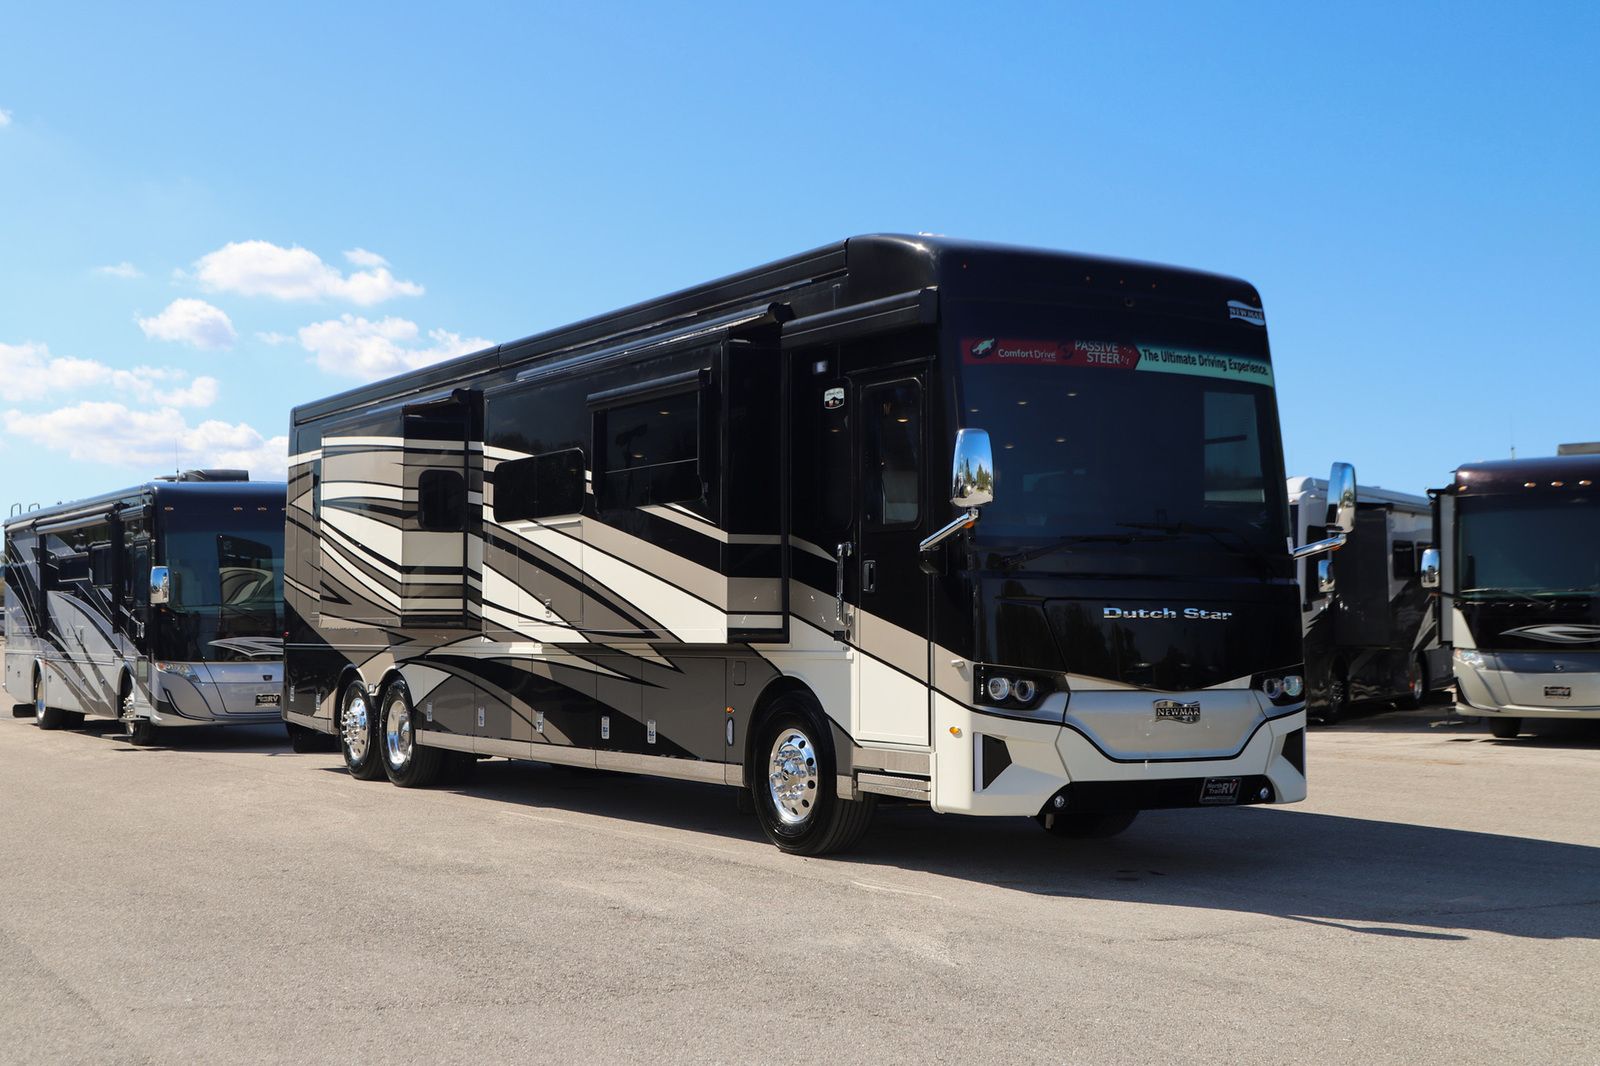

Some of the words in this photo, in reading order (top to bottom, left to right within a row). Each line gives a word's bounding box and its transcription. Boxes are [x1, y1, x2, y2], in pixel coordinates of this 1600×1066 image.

[1075, 340, 1119, 353] PASSIVE
[1087, 352, 1120, 364] STEER
[1142, 349, 1159, 361] The
[1161, 350, 1197, 366] Ultimate
[1199, 354, 1227, 372] Driving
[1103, 607, 1177, 619] Dutch
[1183, 607, 1233, 620] Star
[1157, 707, 1200, 717] NEWMAR
[1221, 782, 1238, 794] RV
